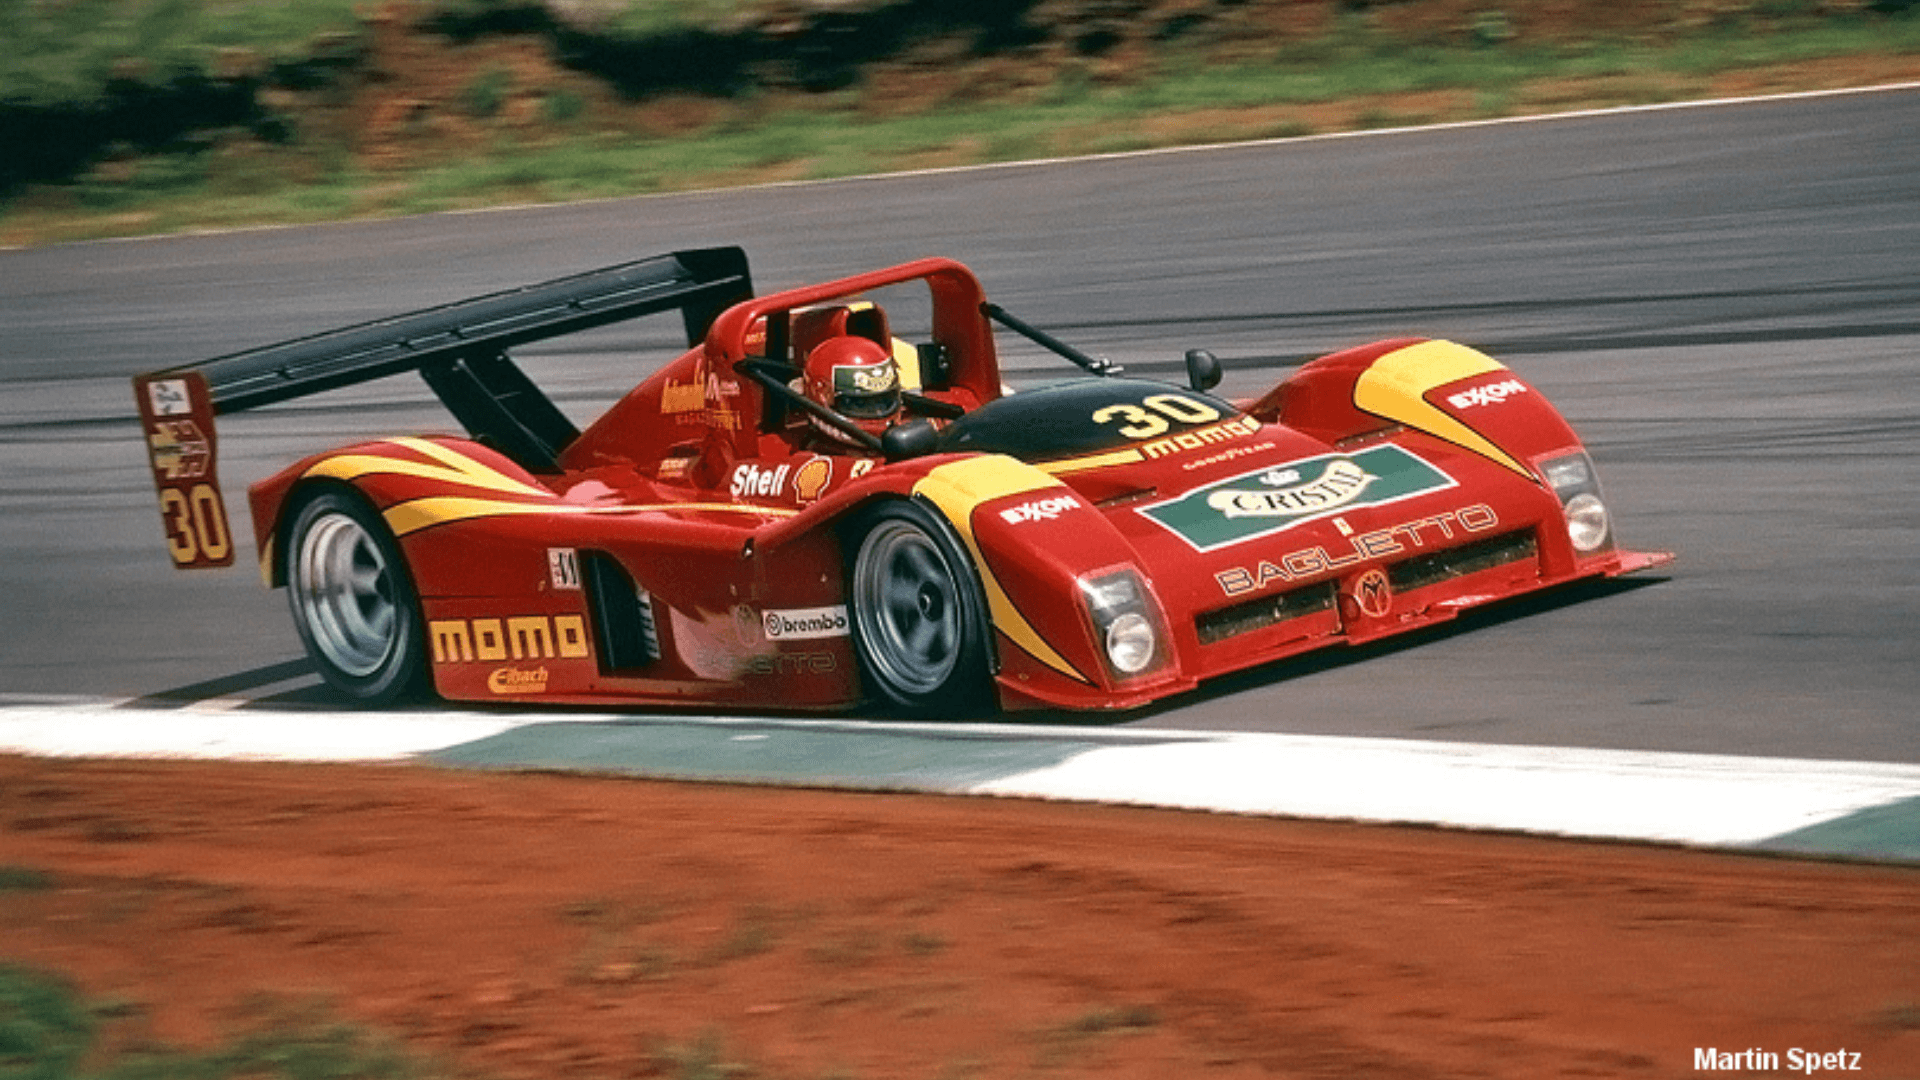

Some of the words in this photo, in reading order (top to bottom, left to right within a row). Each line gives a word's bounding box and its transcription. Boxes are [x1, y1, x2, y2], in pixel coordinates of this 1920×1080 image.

[1446, 379, 1528, 409] EXXON
[1092, 393, 1220, 439] 30
[730, 463, 790, 497] Shell
[161, 483, 228, 563] 30
[999, 494, 1082, 525] EXXON
[1213, 502, 1499, 597] BAGLIETTO
[780, 612, 847, 634] brembo
